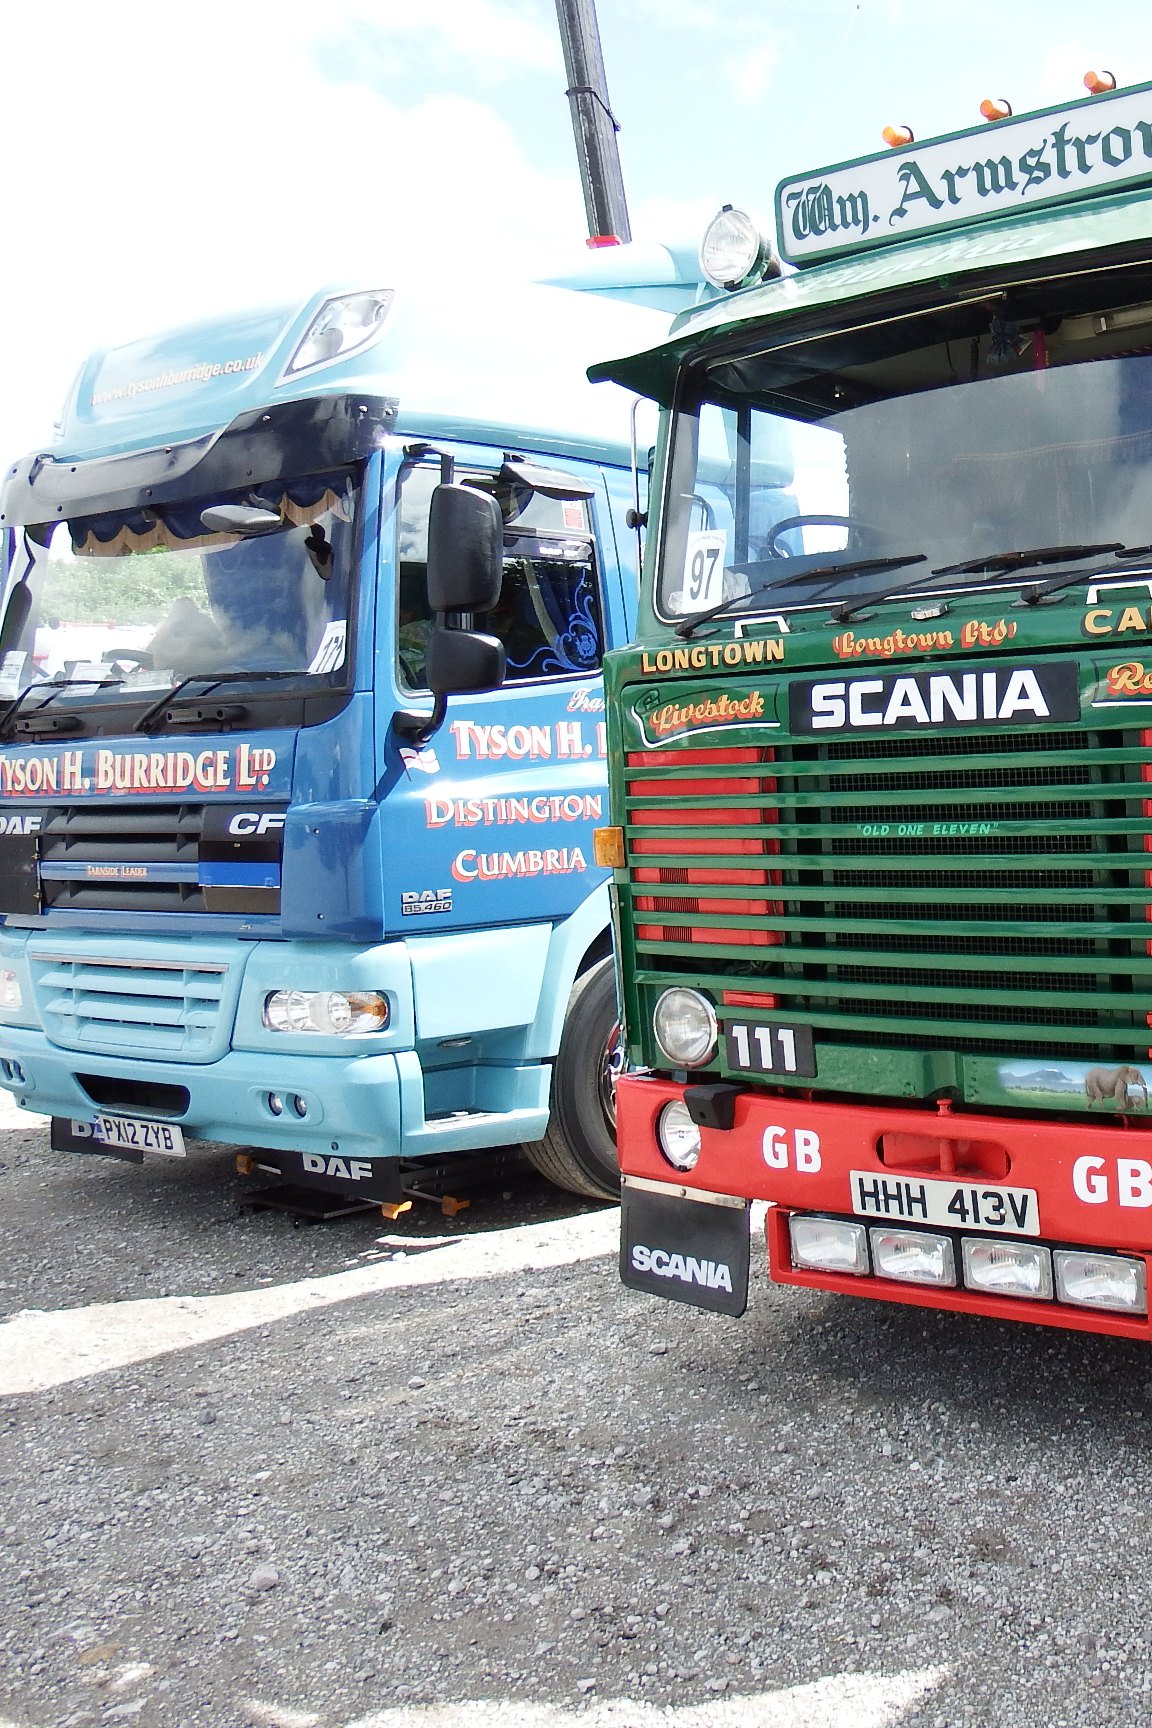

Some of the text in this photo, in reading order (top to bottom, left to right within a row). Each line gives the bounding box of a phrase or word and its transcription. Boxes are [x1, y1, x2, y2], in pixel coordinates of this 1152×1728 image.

[690, 549, 720, 600] 97
[642, 639, 785, 675] LONGTOWN
[650, 690, 765, 735] Livestock
[811, 668, 1050, 729] SCANIA
[451, 720, 552, 759] TYSON
[556, 721, 593, 758] H.
[63, 751, 91, 792] H.
[97, 749, 231, 793] BURRIDGE
[228, 813, 287, 835] CF
[426, 795, 602, 828] DISTINGTON
[898, 824, 925, 836] ONE
[452, 847, 588, 882] CUMBRIA
[402, 888, 453, 903] DAF
[731, 1024, 797, 1072] 111
[103, 1118, 141, 1146] PX12
[142, 1124, 174, 1151] ZYB
[762, 1125, 822, 1173] GB
[301, 1152, 373, 1181] DAF
[858, 1177, 1029, 1229] HHH 413V
[631, 1244, 733, 1293] SCANIA
